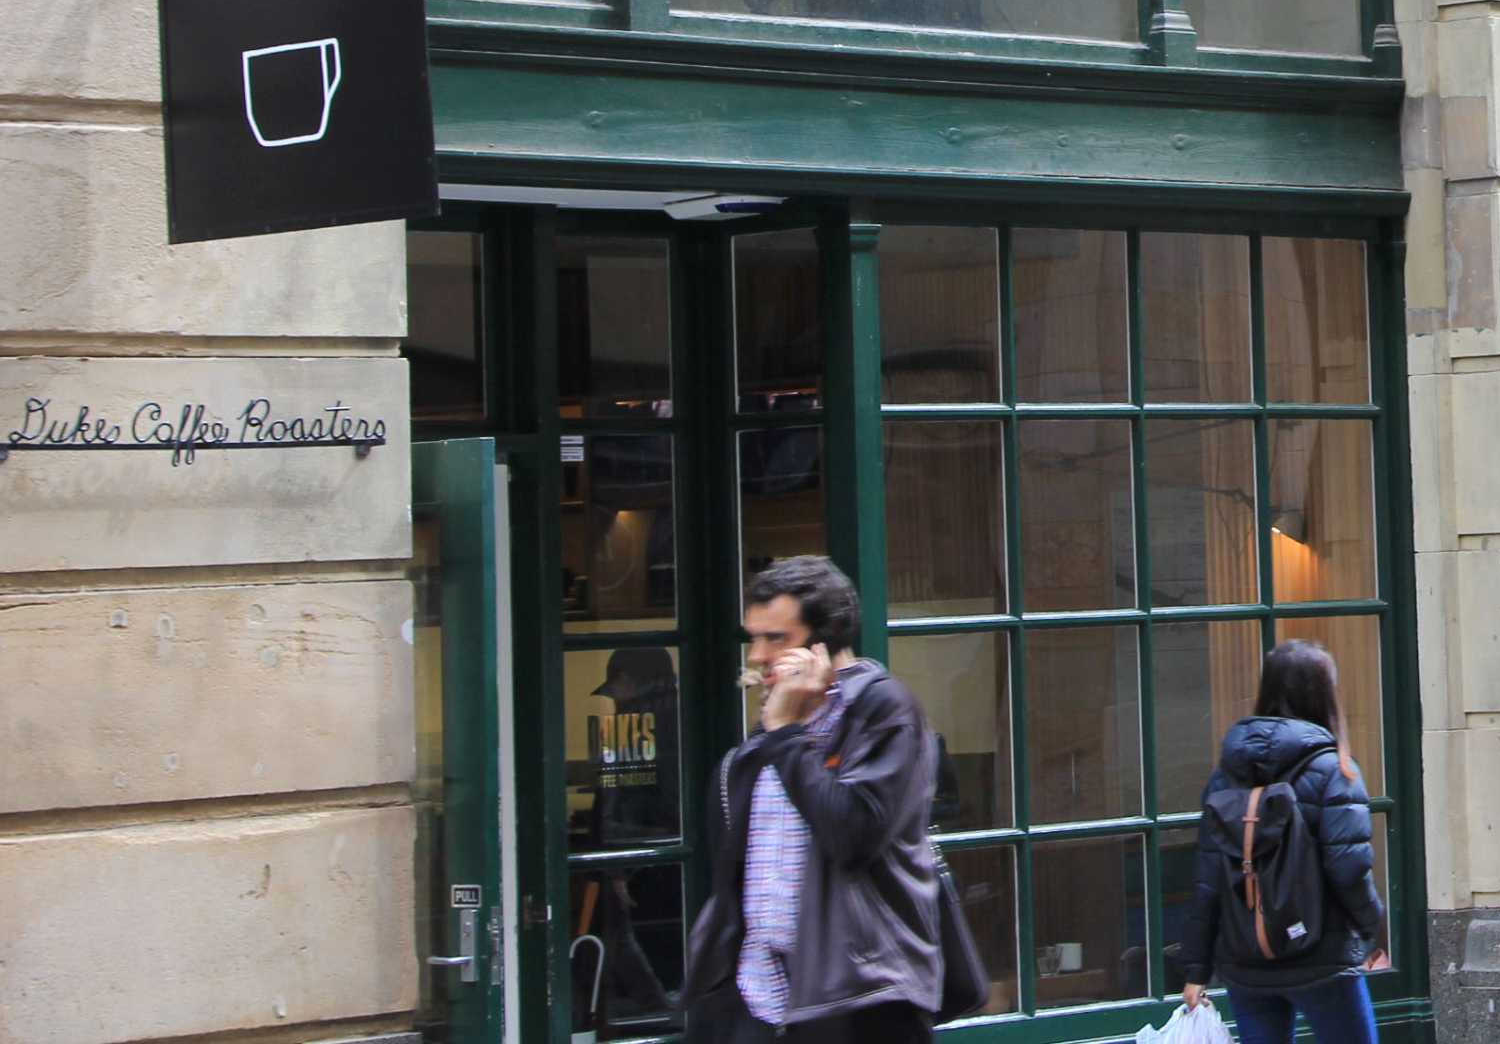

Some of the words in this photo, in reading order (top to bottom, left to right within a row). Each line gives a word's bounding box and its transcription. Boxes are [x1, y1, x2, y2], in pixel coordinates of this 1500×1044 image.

[8, 397, 121, 444] Dukes
[131, 402, 229, 468] Coffee
[235, 399, 387, 444] Roasters
